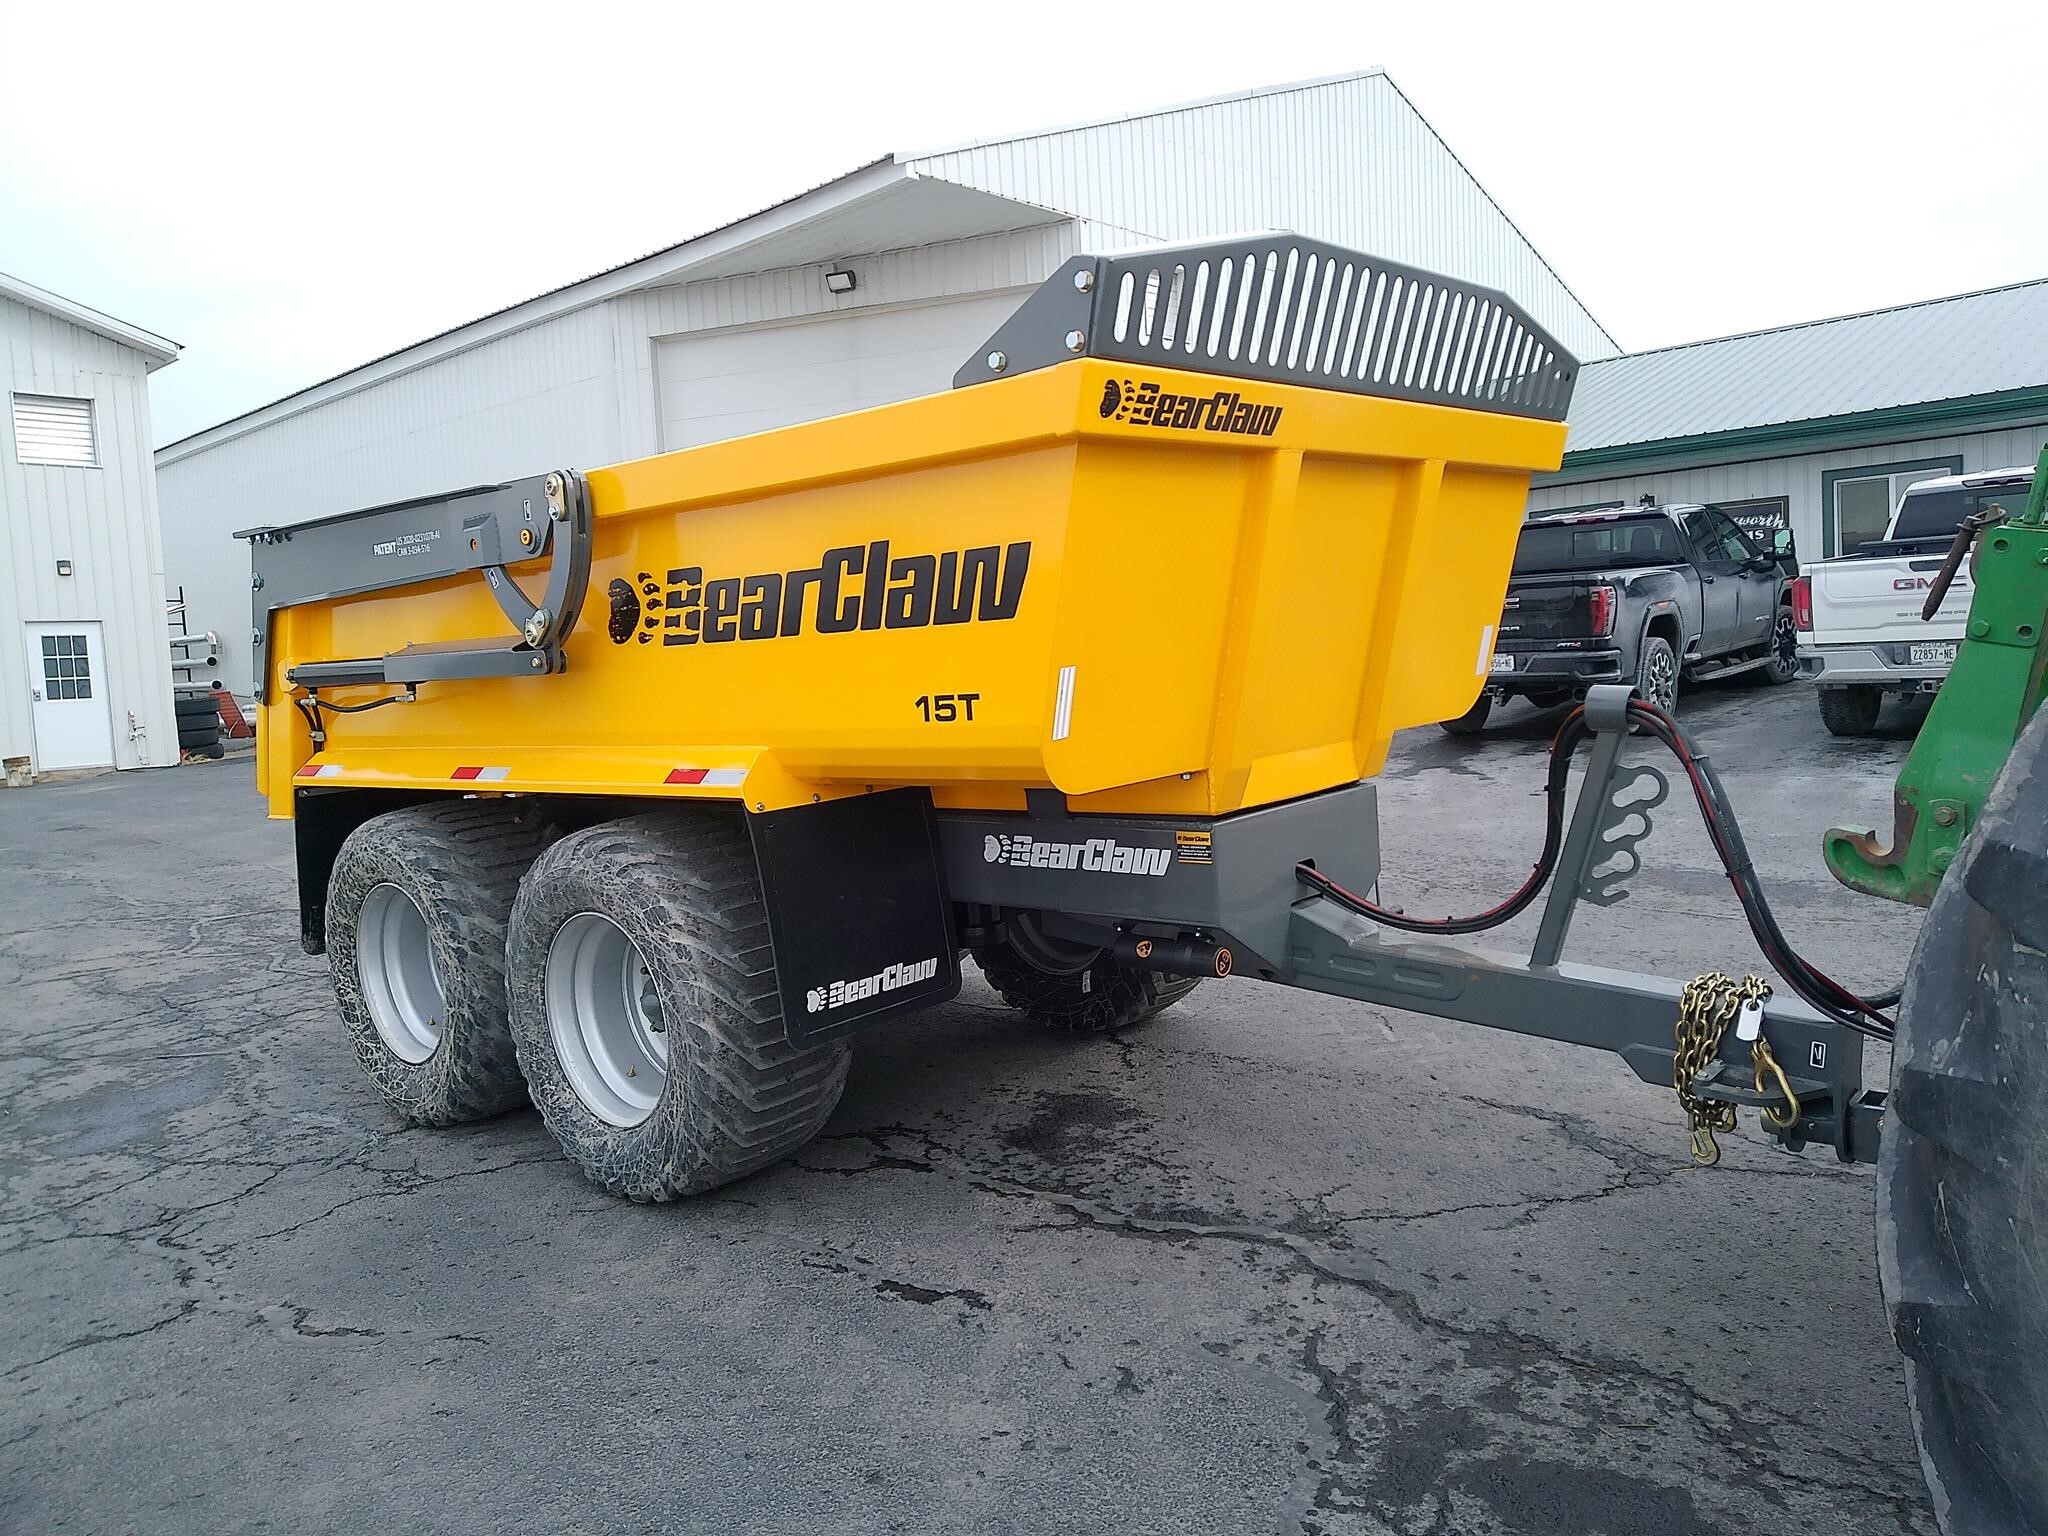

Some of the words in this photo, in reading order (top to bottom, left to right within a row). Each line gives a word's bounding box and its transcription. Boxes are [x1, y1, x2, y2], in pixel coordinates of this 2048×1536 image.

[1129, 382, 1284, 436] BearClaw
[373, 541, 396, 556] PATENT
[663, 539, 1032, 647] BearClaw
[915, 693, 980, 723] 15T
[1010, 835, 1172, 877] BearClaw
[829, 957, 938, 1009] BearClaw
